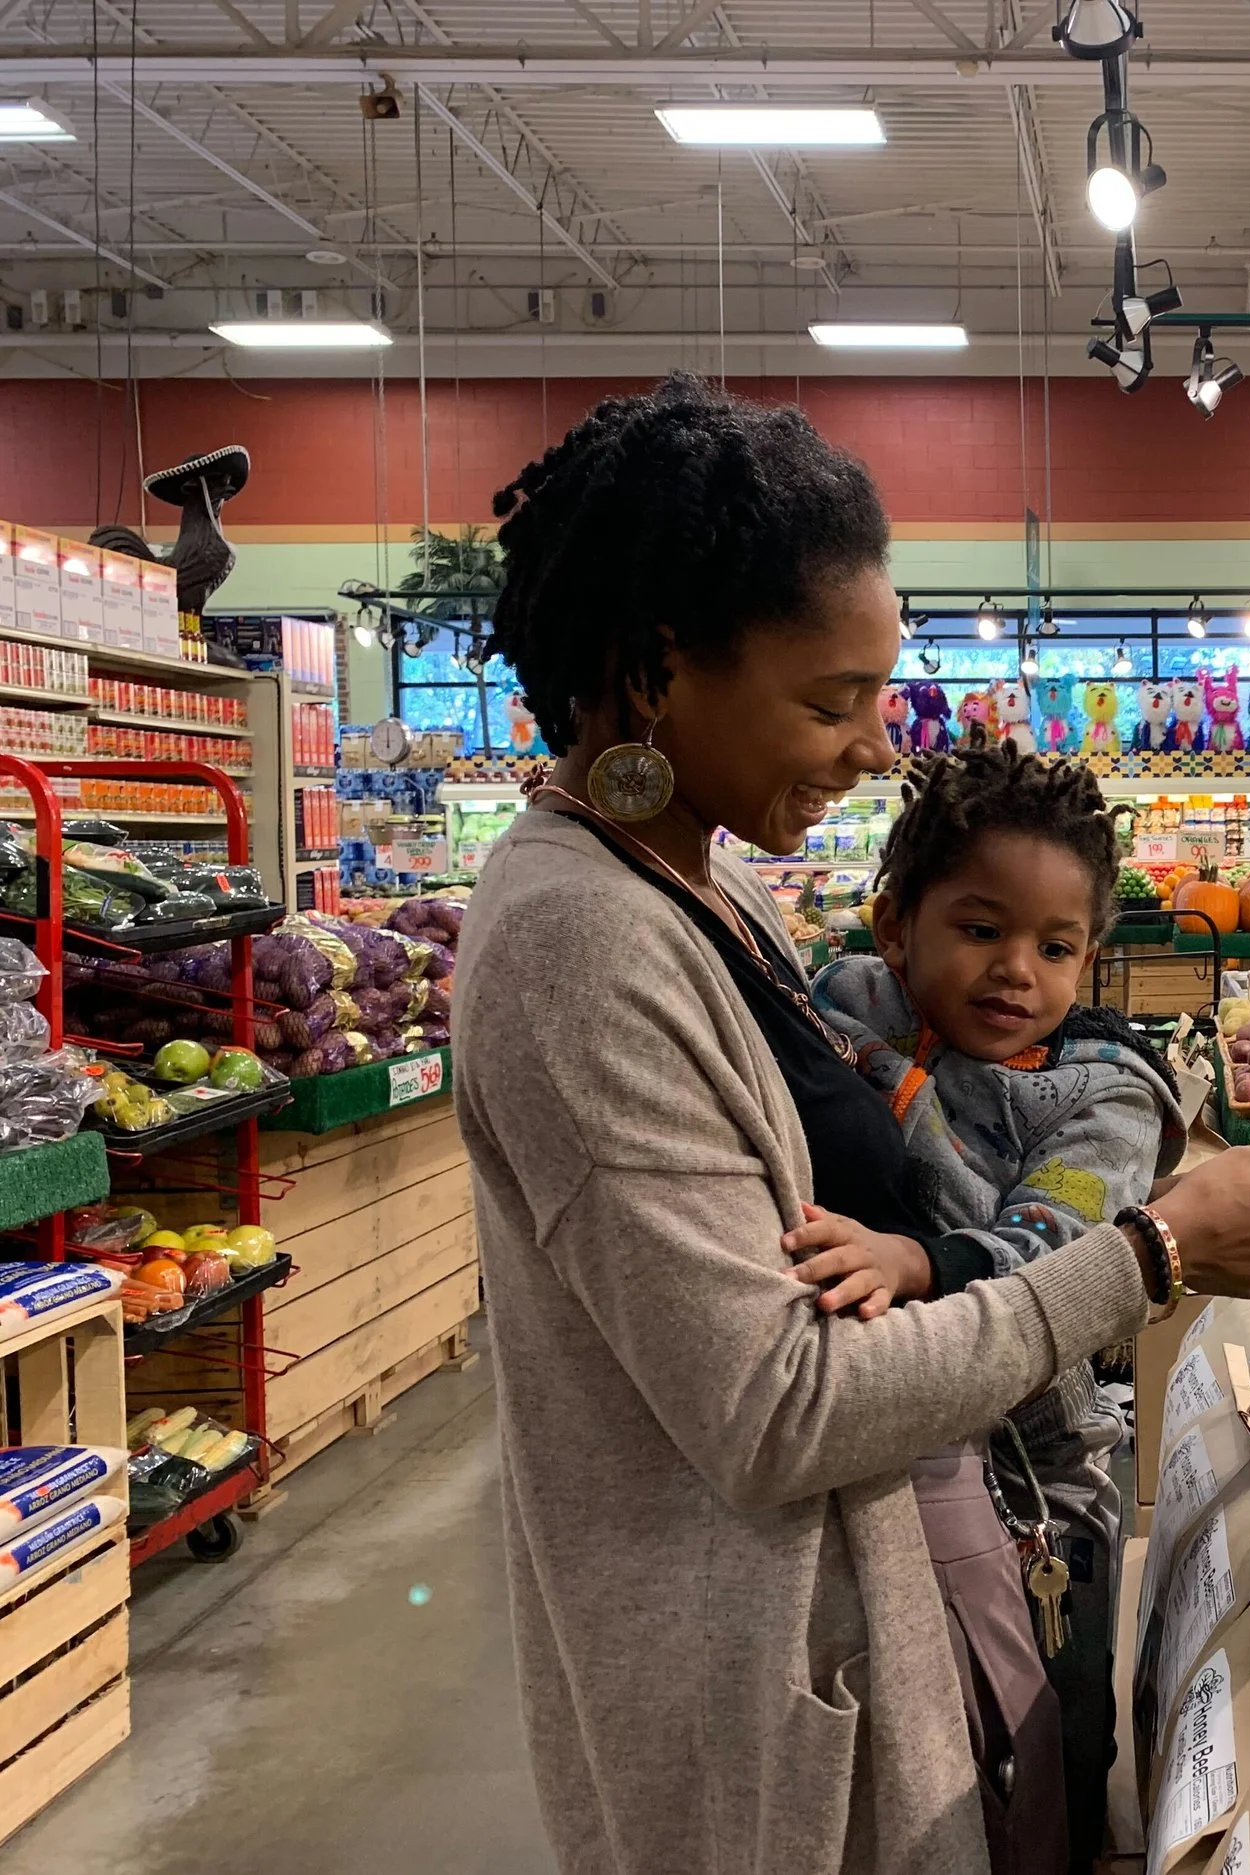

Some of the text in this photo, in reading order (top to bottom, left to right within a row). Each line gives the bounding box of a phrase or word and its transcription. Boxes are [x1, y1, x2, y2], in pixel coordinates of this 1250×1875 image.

[28, 1468, 98, 1512] ARROZ GRANO MEDIANO
[26, 1518, 93, 1565] ARROZ GRANO MEDIANO
[1187, 1701, 1214, 1778] Honey Bee
[1192, 1778, 1202, 1811] Calories
[1226, 1764, 1235, 1797] Nutrition
